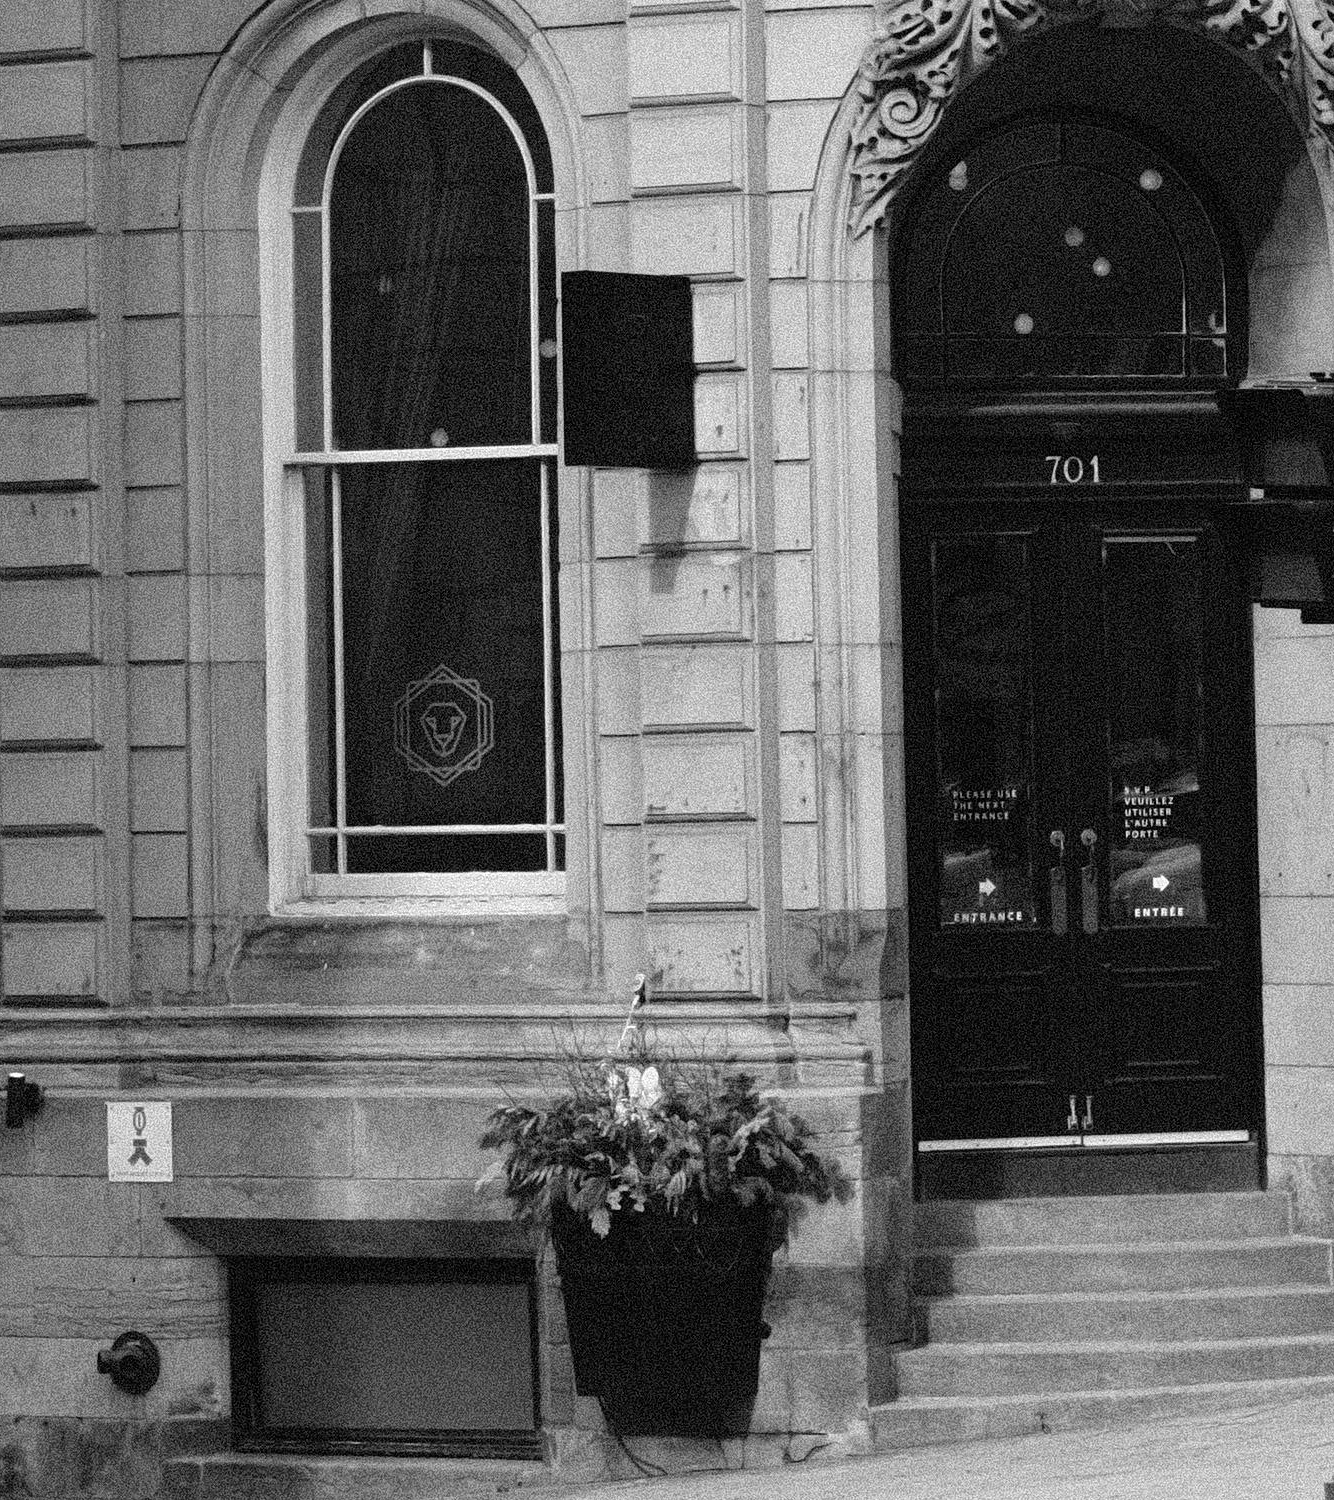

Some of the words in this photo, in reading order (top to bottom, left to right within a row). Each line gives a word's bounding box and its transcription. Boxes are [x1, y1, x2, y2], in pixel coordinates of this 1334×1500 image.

[1045, 455, 1100, 484] 701
[952, 789, 992, 799] PLEASE
[997, 788, 1017, 799] USE
[953, 801, 973, 810] THE
[977, 800, 1005, 809] NEXT
[1124, 796, 1174, 806] VEUILLEZ
[953, 811, 1009, 821] ENTRANCE
[1124, 807, 1172, 817] UTILISER
[1124, 818, 1168, 828] L'AUTRE
[1125, 829, 1159, 839] PORTE
[953, 911, 1023, 923] ENTRANCE
[1134, 906, 1184, 918] ENTRÉE
